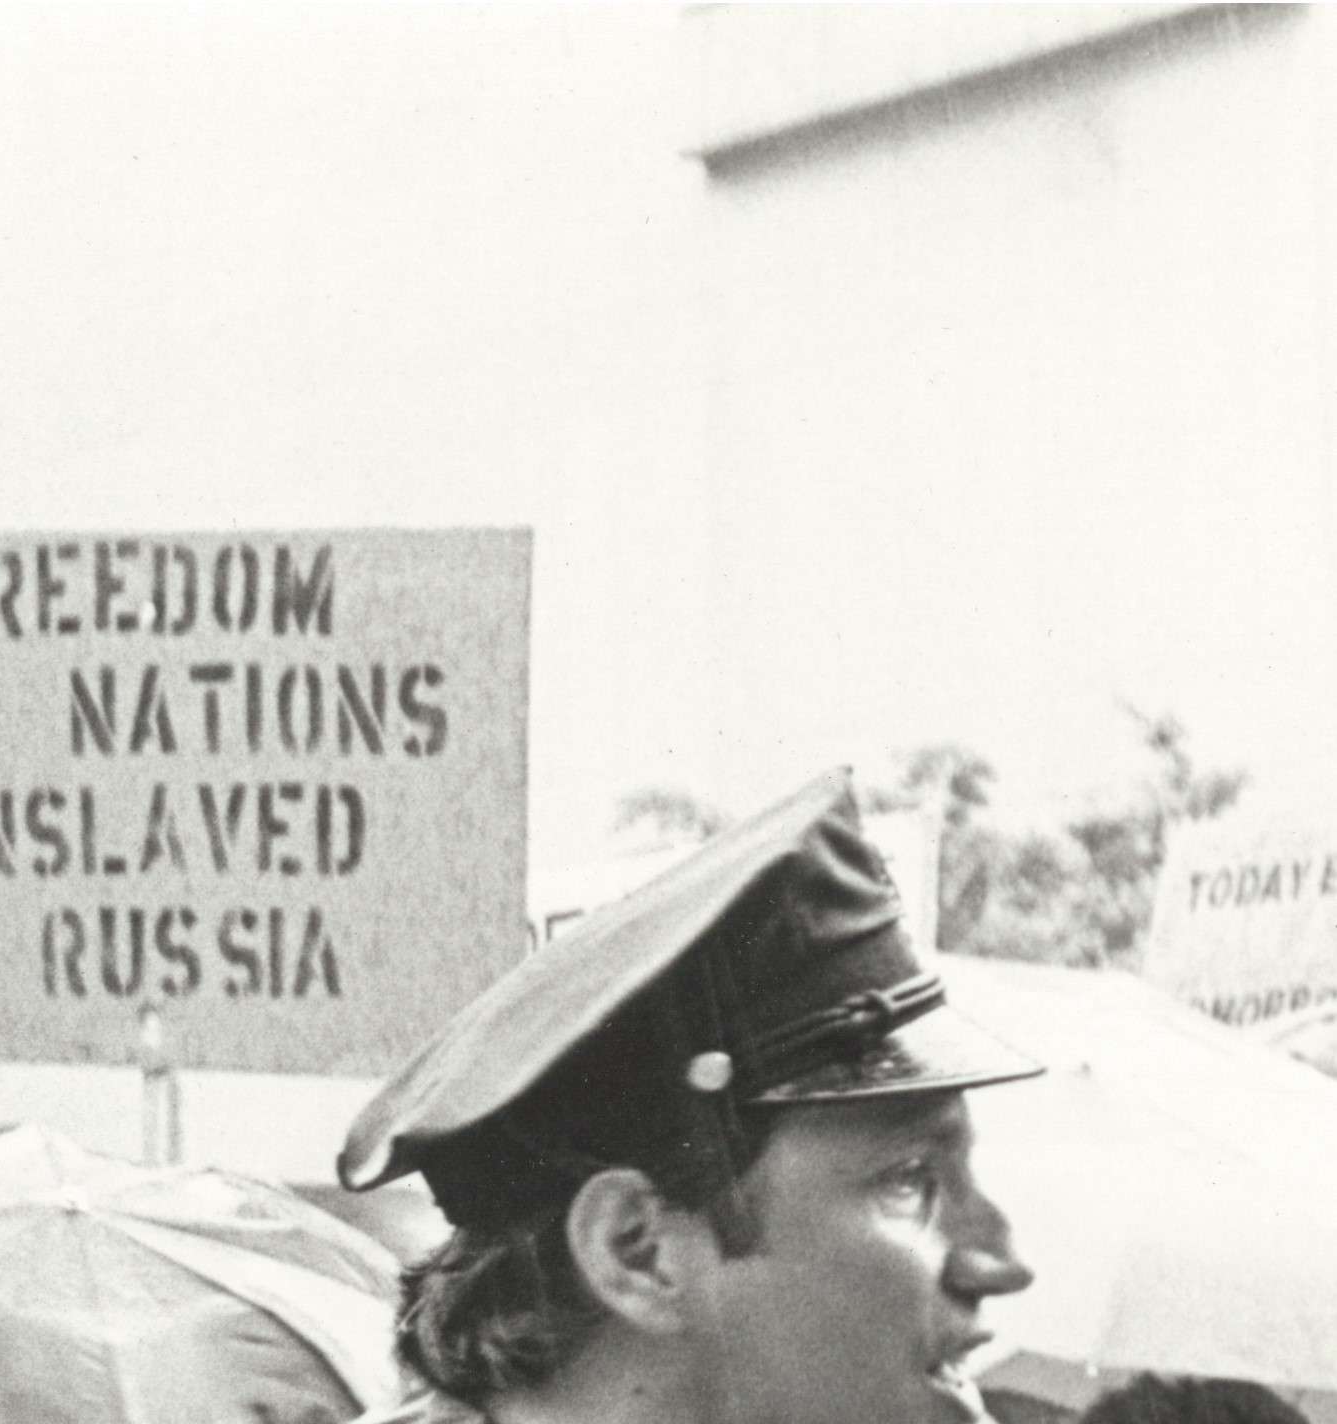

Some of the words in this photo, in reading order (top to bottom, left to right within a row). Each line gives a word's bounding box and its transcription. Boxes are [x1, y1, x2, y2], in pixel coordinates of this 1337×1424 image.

[70, 662, 449, 757] NATIONS
[1189, 857, 1313, 913] TODAY
[41, 905, 342, 1000] RUSSIA
